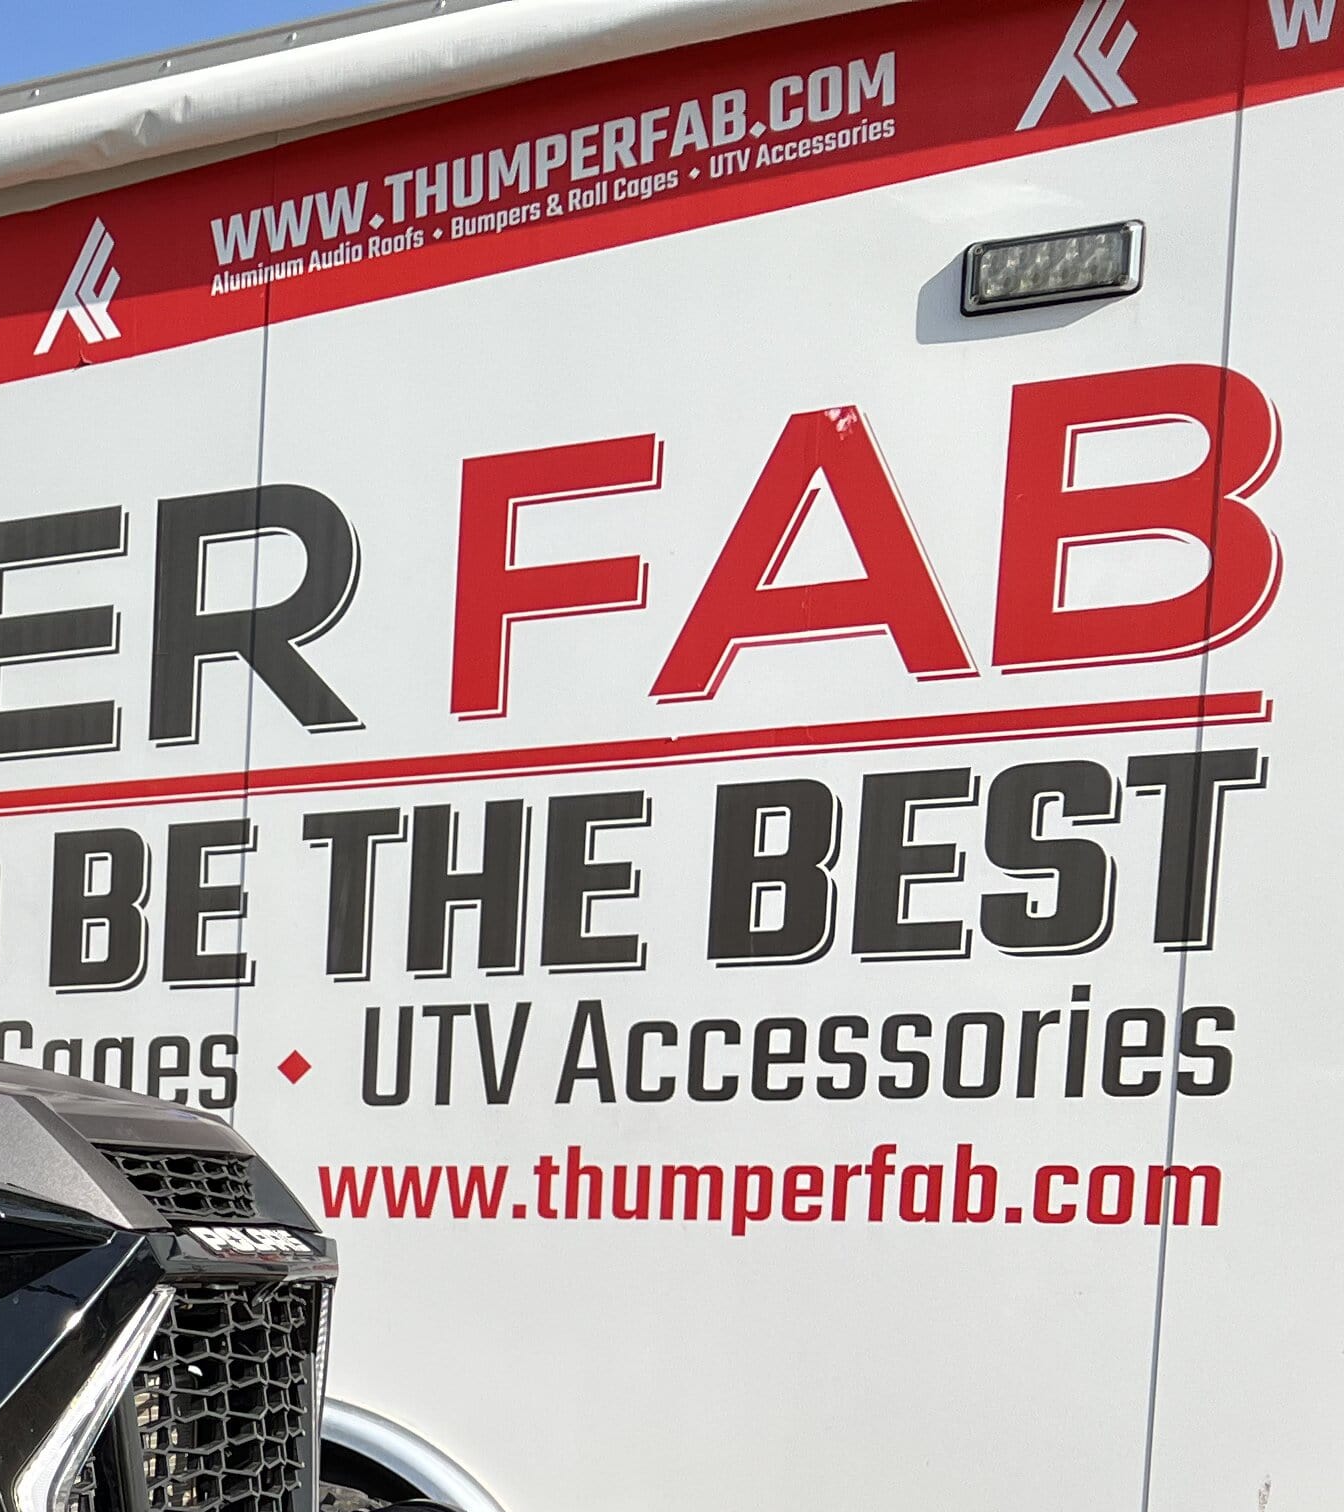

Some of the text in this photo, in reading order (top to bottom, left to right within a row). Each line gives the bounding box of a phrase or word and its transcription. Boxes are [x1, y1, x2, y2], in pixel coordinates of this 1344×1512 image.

[210, 50, 896, 267] WWW.THUMPERFAB.COM
[210, 118, 897, 297] Aluminum Audio Roofs Bumpers & Roll Cages UTV Accessories
[449, 362, 1282, 723] FAB
[48, 816, 259, 993] BE
[301, 789, 652, 984] THE
[707, 746, 1269, 967] BEST
[360, 999, 532, 1108] UTV
[553, 983, 1238, 1105] Accessories
[317, 1141, 1222, 1237] www.thumperfab.com
